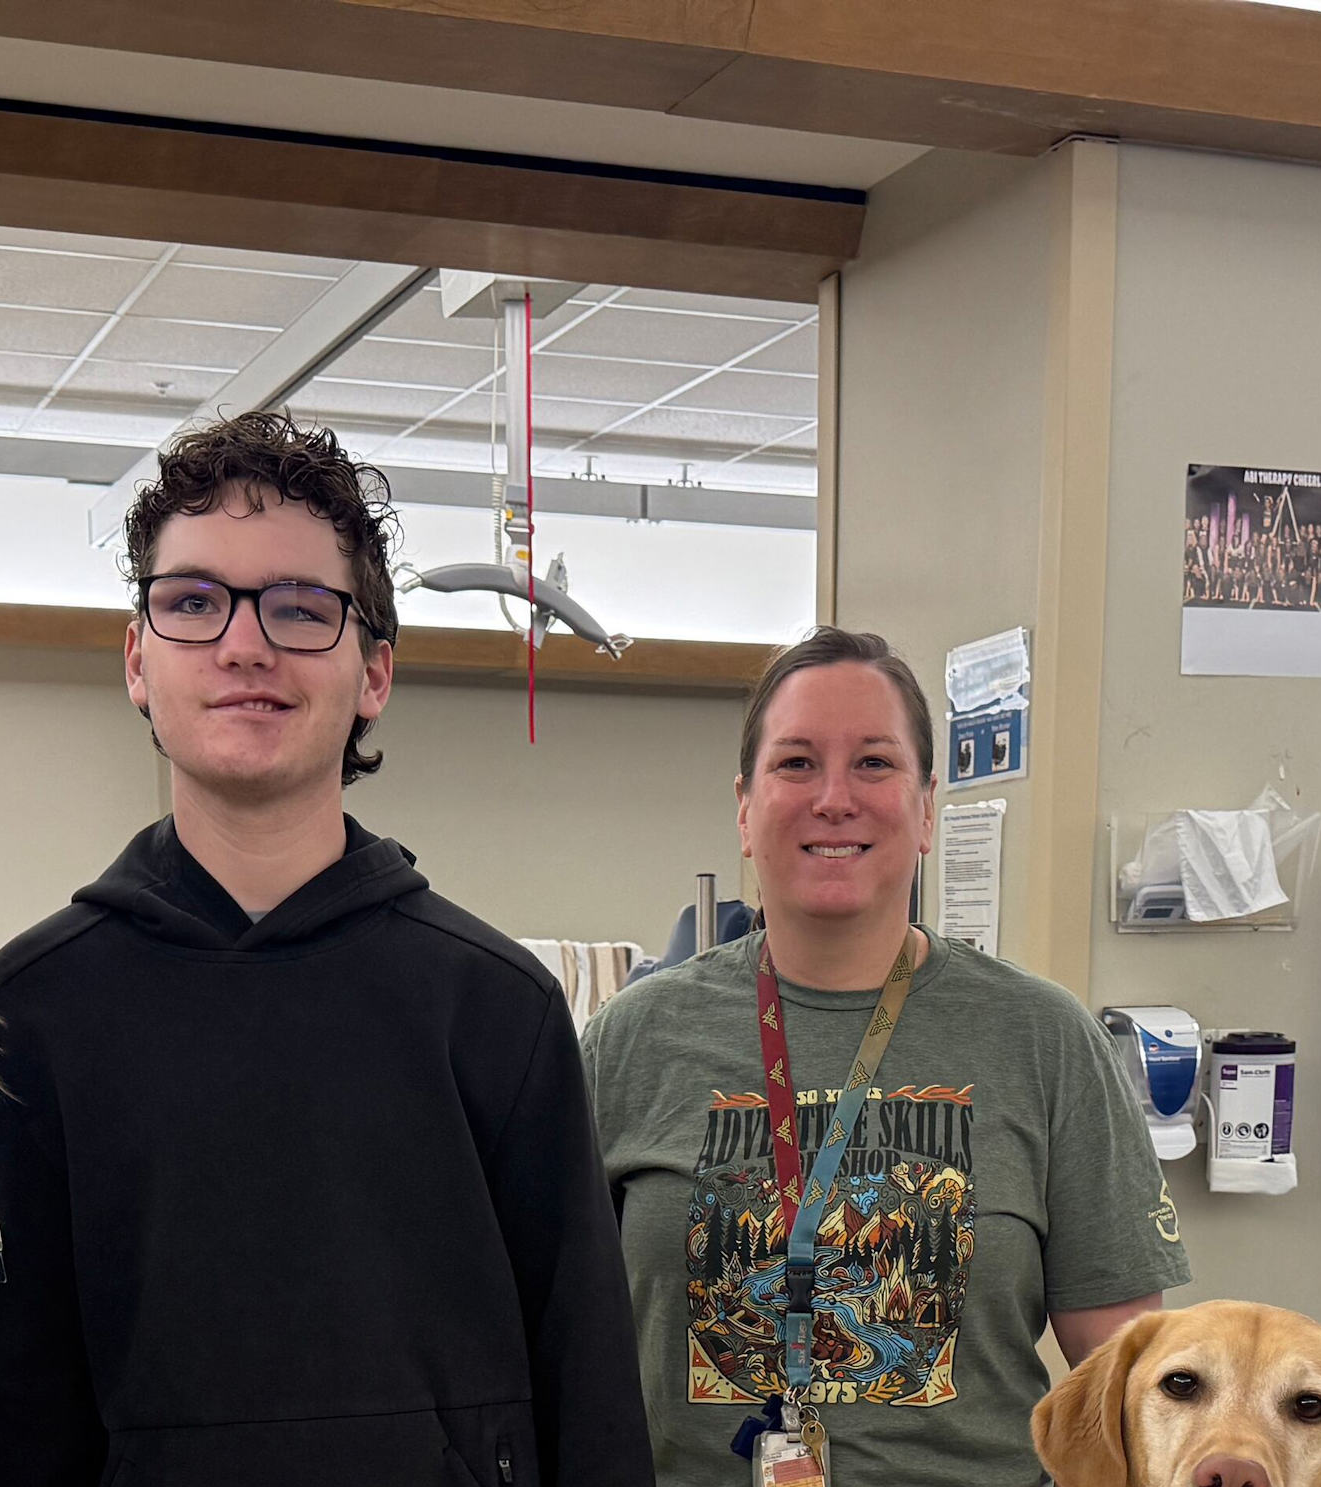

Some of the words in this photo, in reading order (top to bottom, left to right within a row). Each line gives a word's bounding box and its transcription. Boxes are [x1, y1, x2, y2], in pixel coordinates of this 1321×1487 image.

[1258, 471, 1293, 485] THERAPY
[796, 1089, 818, 1105] 50
[878, 1100, 974, 1177] SKILLS
